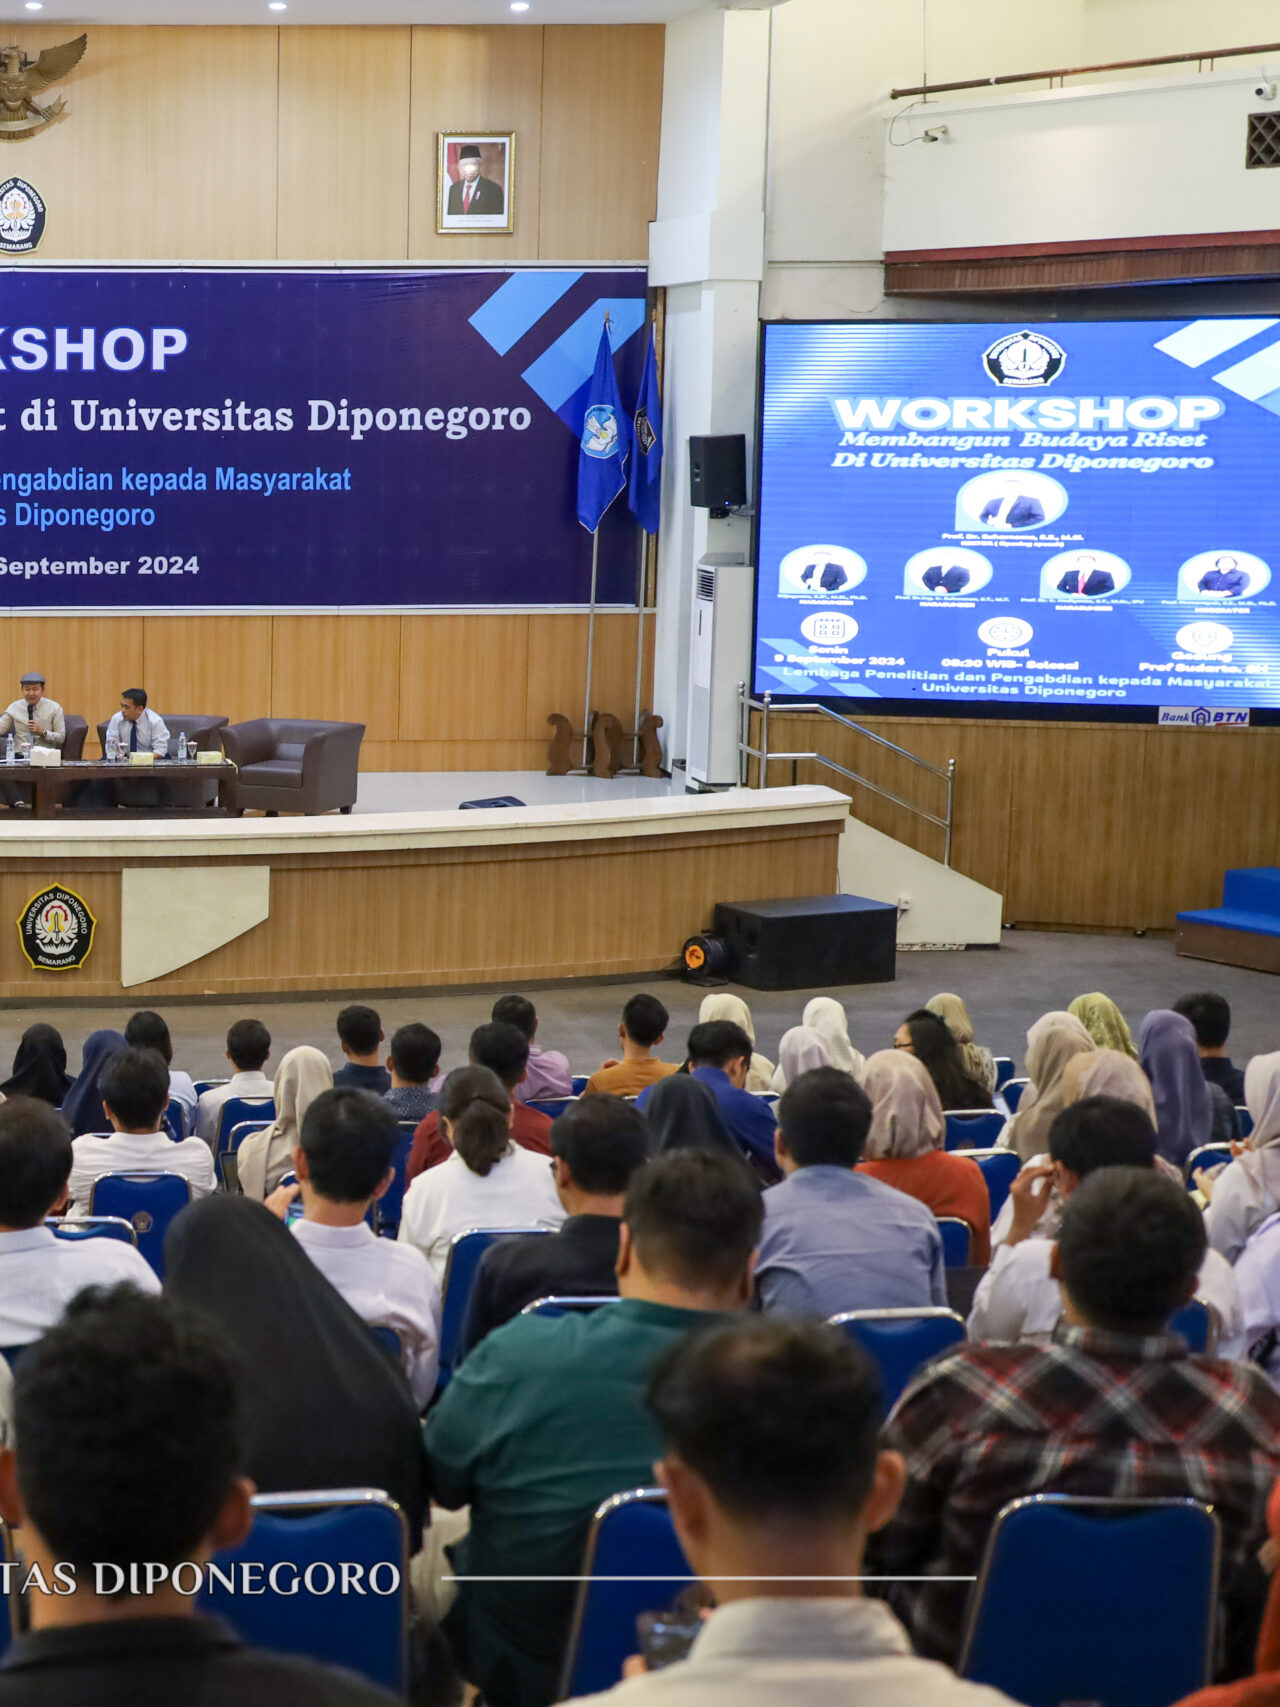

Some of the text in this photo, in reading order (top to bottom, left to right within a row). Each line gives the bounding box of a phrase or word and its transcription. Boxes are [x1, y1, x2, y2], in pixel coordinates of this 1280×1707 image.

[17, 180, 43, 212] DIPONEGORO
[21, 399, 57, 431] di
[71, 399, 293, 431] Universitas
[308, 399, 531, 440] Diponegoro
[835, 399, 1220, 429] WORKSHOP
[839, 432, 1208, 451] Membangun Budaya Riset
[832, 453, 1213, 472] Di Universitas Diponegoro
[122, 467, 206, 496] kepada
[216, 467, 351, 496] Masyarakat
[16, 503, 155, 531] Diponegoro
[138, 556, 199, 574] 2024
[808, 646, 848, 654] Senin
[987, 648, 1029, 657] Pukul
[1172, 652, 1232, 663] Gedung
[774, 654, 905, 666] 9 September 2024
[942, 658, 983, 668] 08:30
[1026, 660, 1079, 670] Selesai
[1139, 662, 1173, 672] Prof
[783, 668, 1271, 689] Lembaga Penelitian dan Pengabdian kepada Masyarakat
[922, 683, 1127, 699] Universitas Diponegoro
[1162, 712, 1248, 723] Bank BTN
[26, 892, 87, 935] UNIVERSITAS DIPONEGORO
[38, 955, 76, 965] SEMARANG
